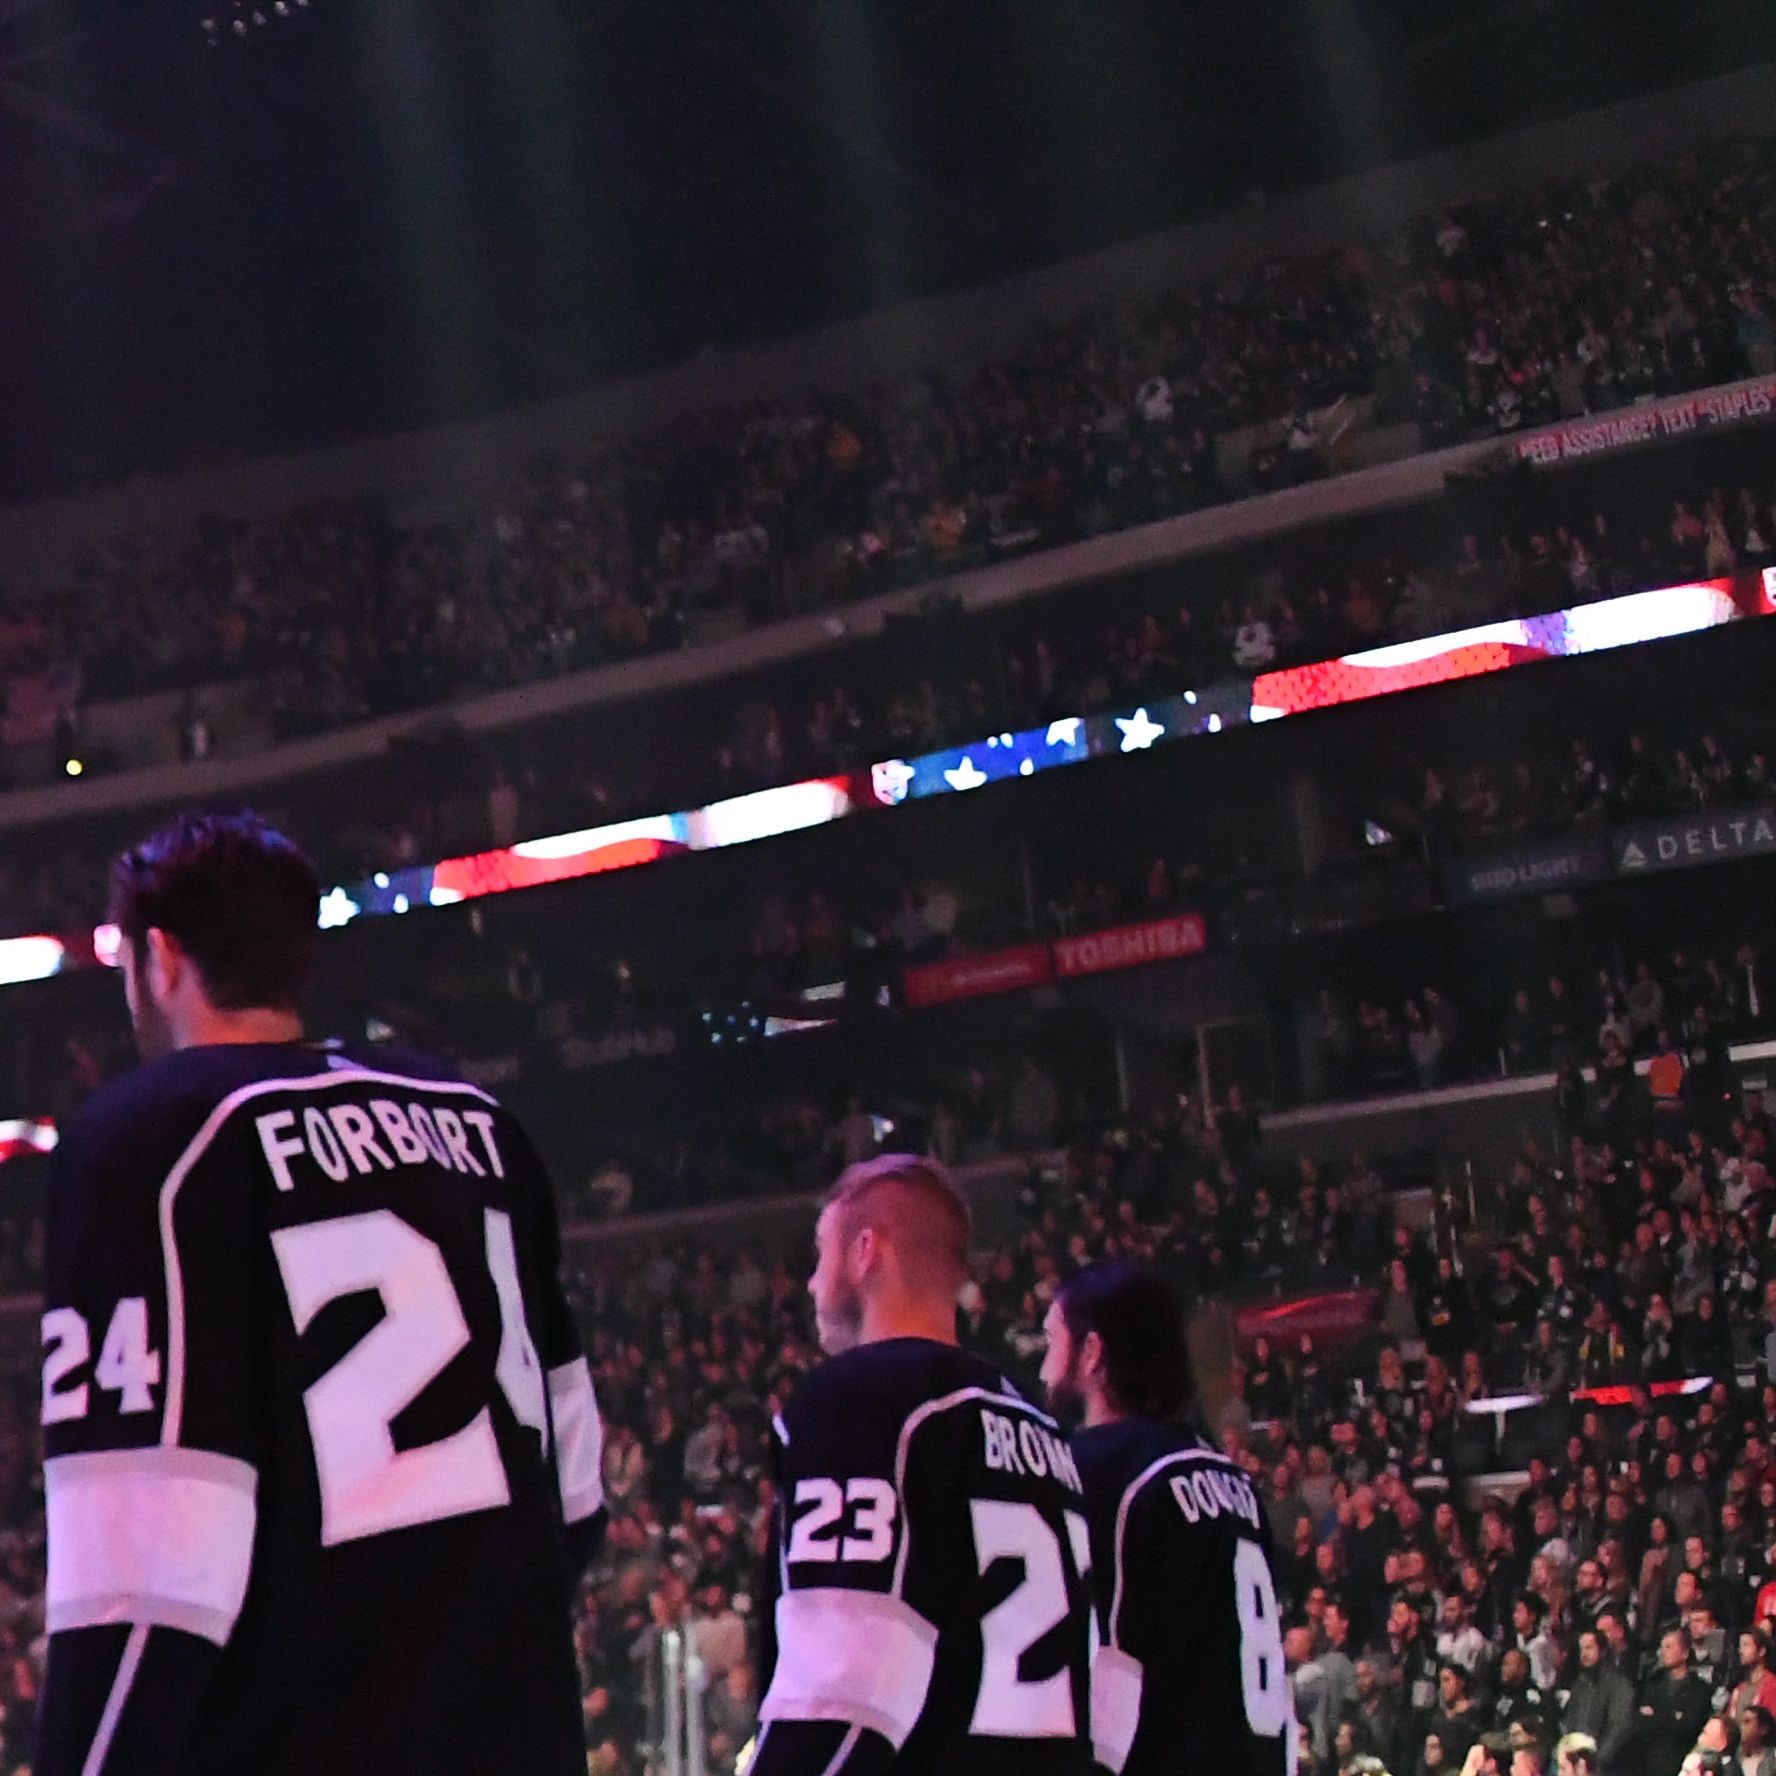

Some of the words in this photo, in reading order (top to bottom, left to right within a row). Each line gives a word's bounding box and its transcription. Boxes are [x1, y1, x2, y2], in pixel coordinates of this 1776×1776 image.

[1657, 819, 1774, 861] DELTA
[1058, 919, 1202, 972] TOSHIBA
[256, 1099, 506, 1191] FORBORT
[41, 1297, 160, 1425] 24
[788, 1478, 897, 1562] 23
[1233, 1537, 1288, 1738] 8
